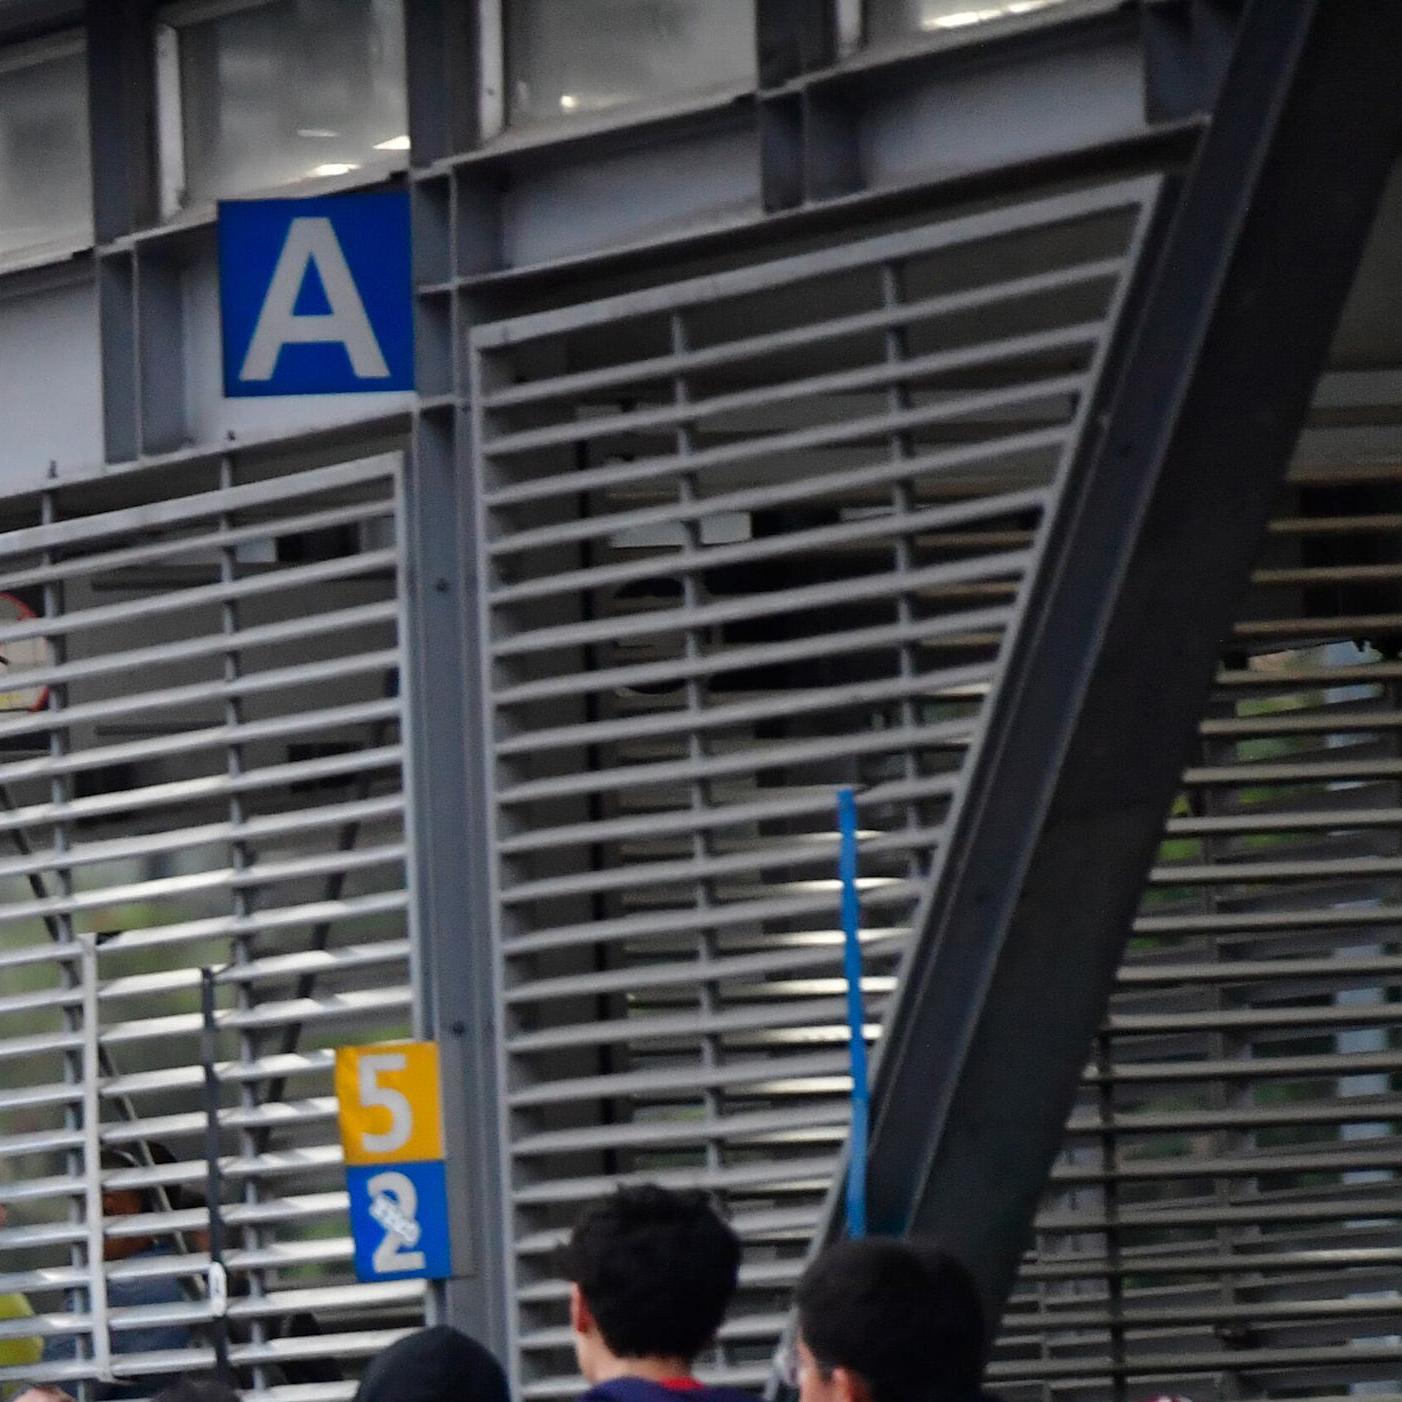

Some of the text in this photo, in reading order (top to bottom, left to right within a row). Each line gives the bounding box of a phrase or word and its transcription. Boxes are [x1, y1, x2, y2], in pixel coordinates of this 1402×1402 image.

[238, 216, 392, 382] A
[359, 1053, 414, 1154] 5
[366, 1171, 427, 1273] 2
